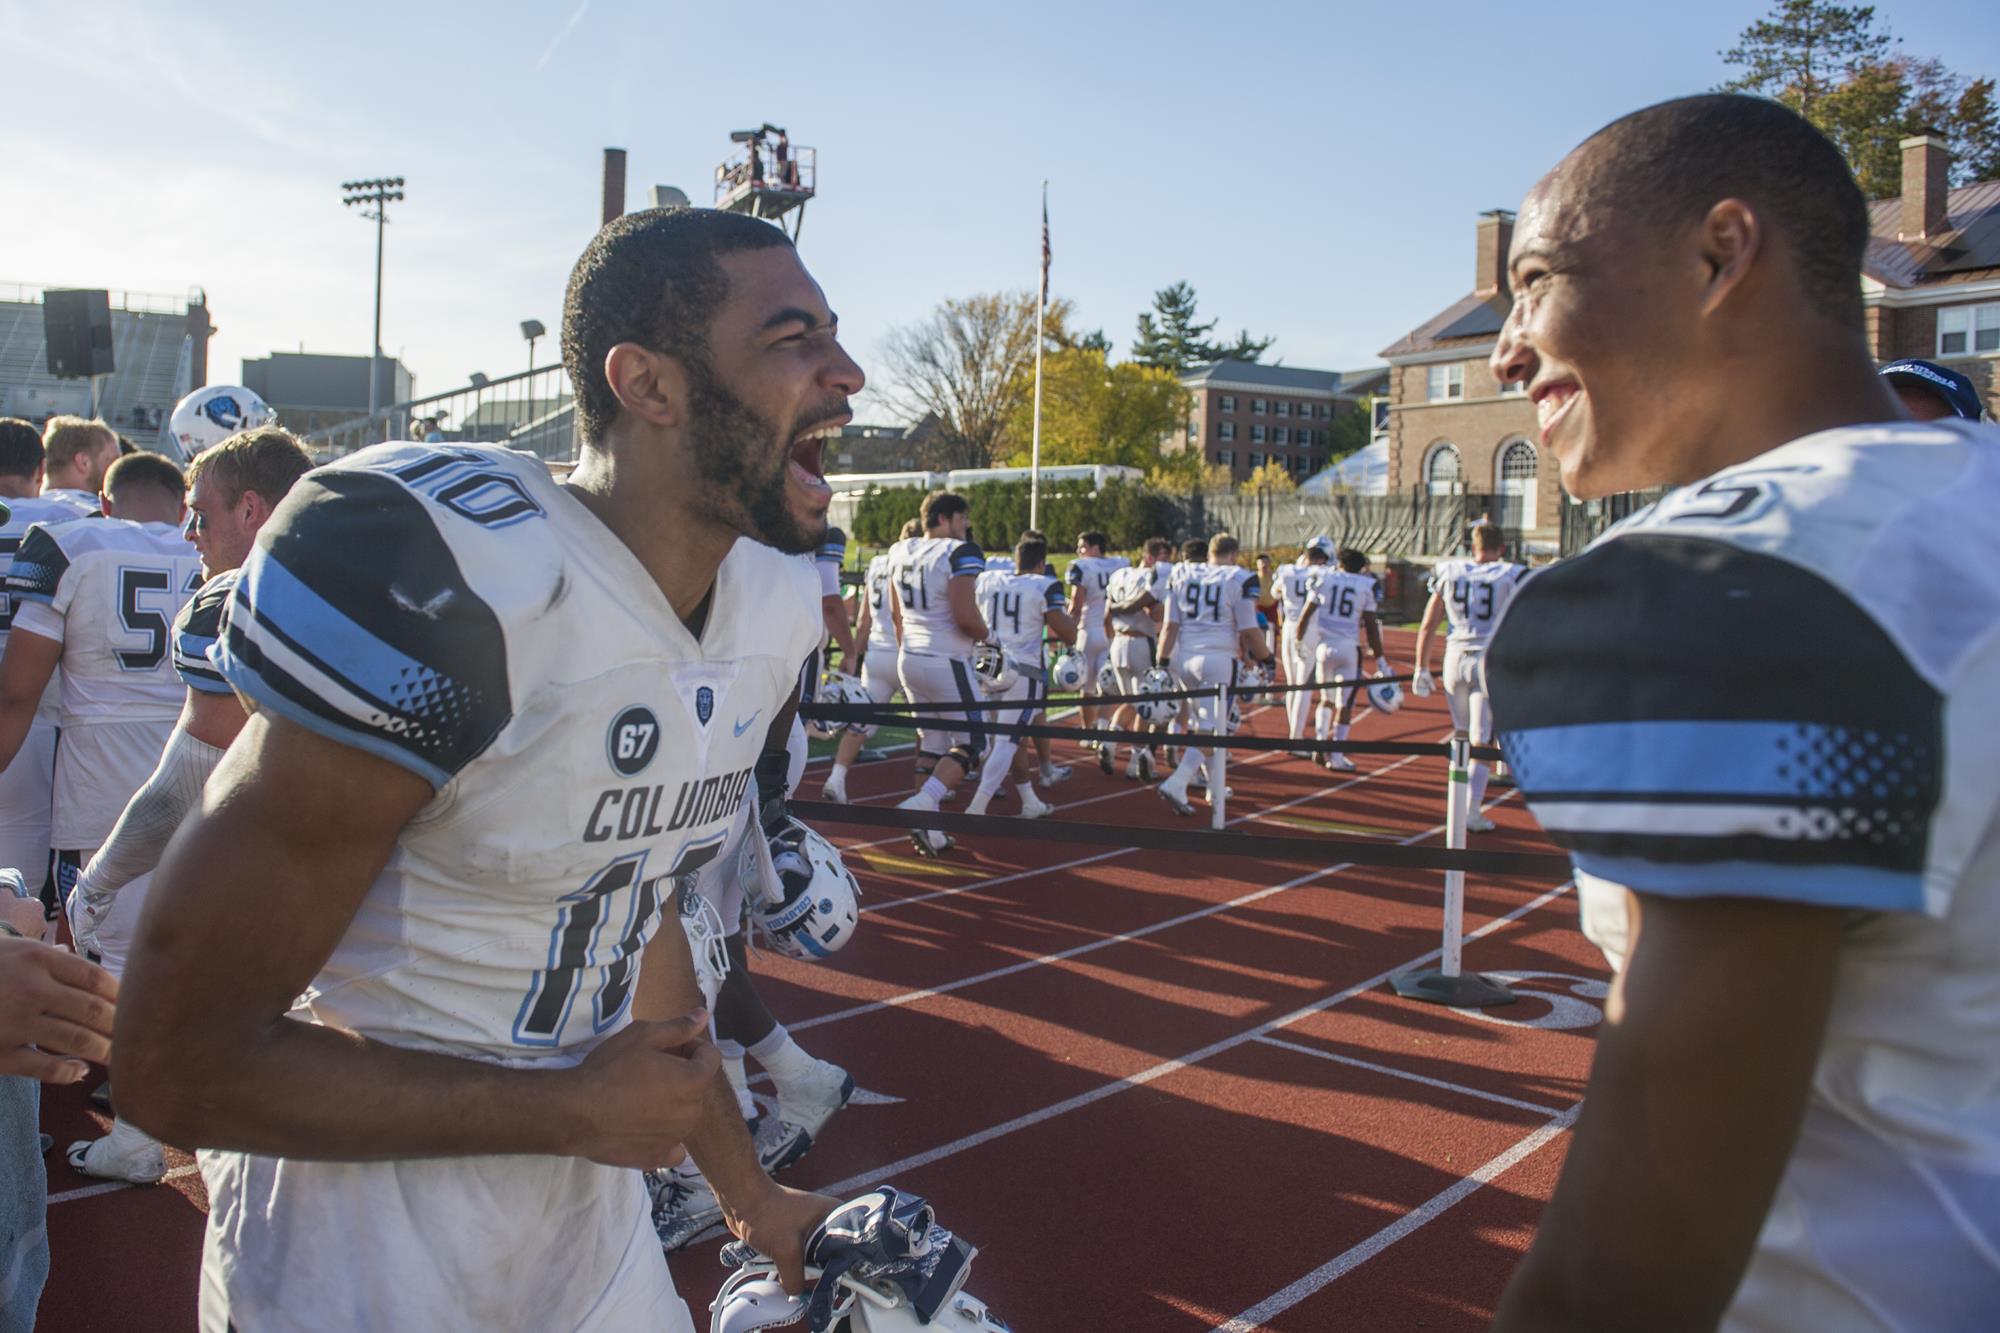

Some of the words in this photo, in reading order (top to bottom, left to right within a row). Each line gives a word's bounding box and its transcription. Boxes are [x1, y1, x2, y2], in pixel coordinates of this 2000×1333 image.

[901, 565, 927, 610] 51
[1186, 583, 1221, 622] 94
[1328, 584, 1355, 618] 16
[1453, 580, 1493, 620] 43
[112, 565, 206, 672] 5
[992, 592, 1020, 634] 14
[617, 723, 655, 760] 67
[582, 767, 752, 843] COLUMBIA
